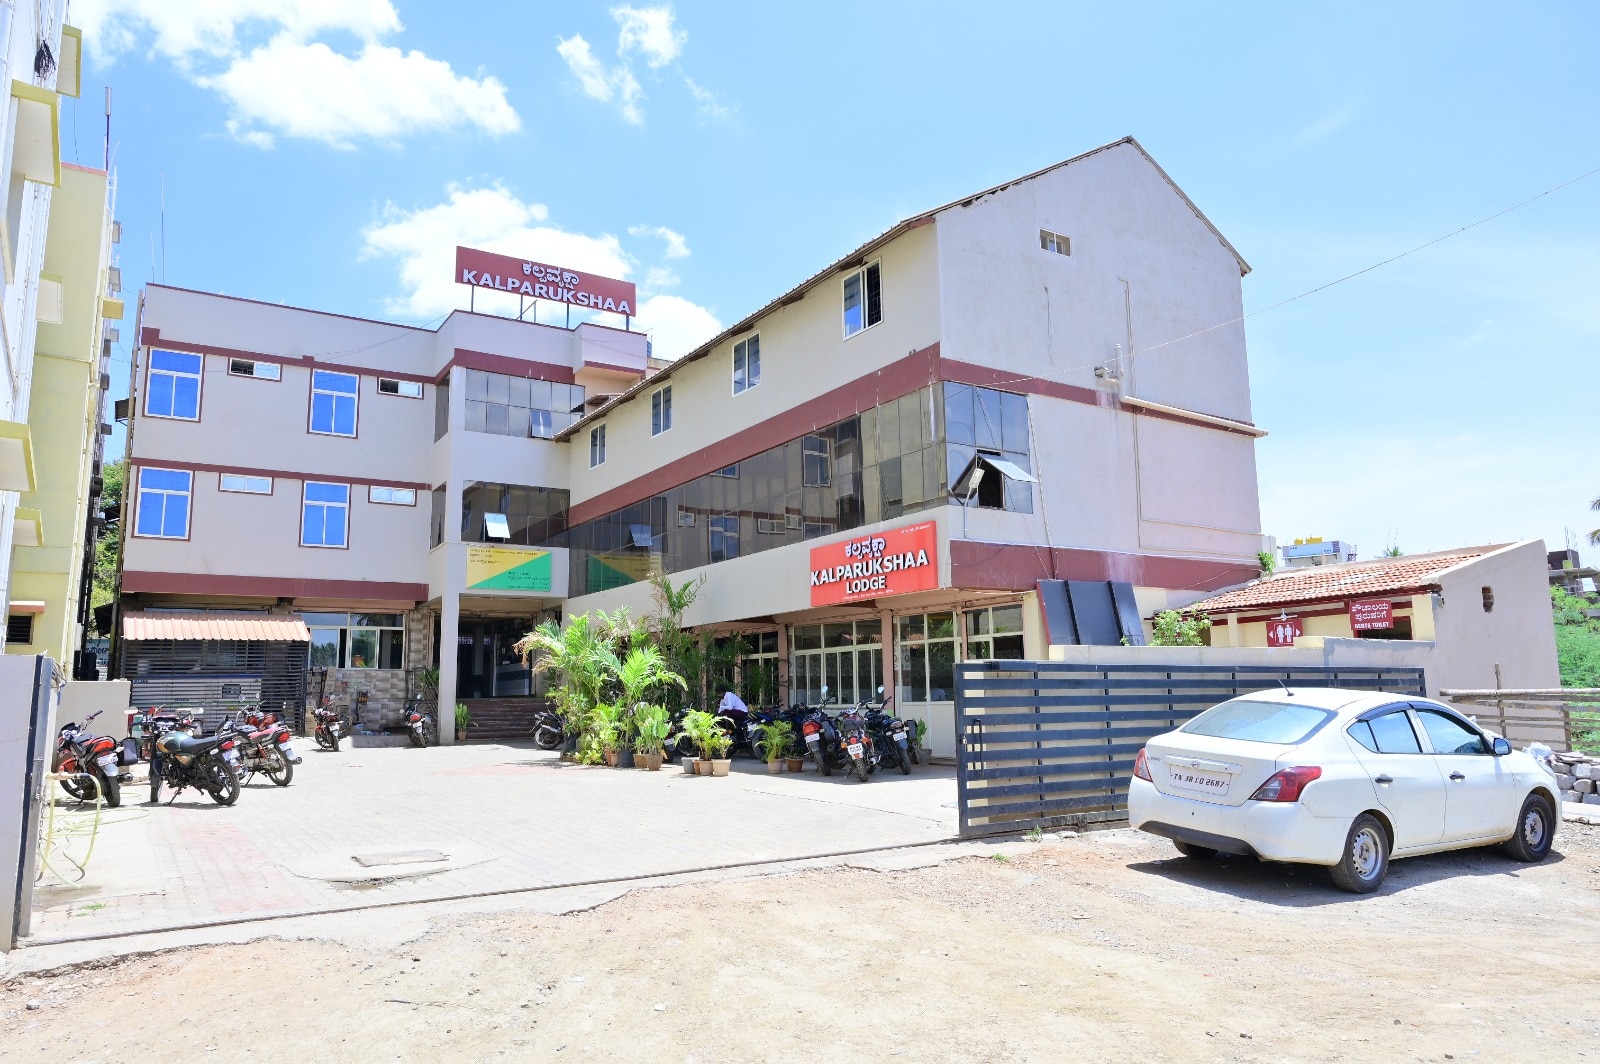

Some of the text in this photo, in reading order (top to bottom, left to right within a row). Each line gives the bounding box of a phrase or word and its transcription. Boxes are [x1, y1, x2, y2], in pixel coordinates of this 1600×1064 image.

[462, 269, 631, 314] KALPARUKSHAA
[811, 549, 929, 586] KALPARUKSHAA
[846, 575, 886, 594] LODGE
[1205, 778, 1225, 788] 2687
